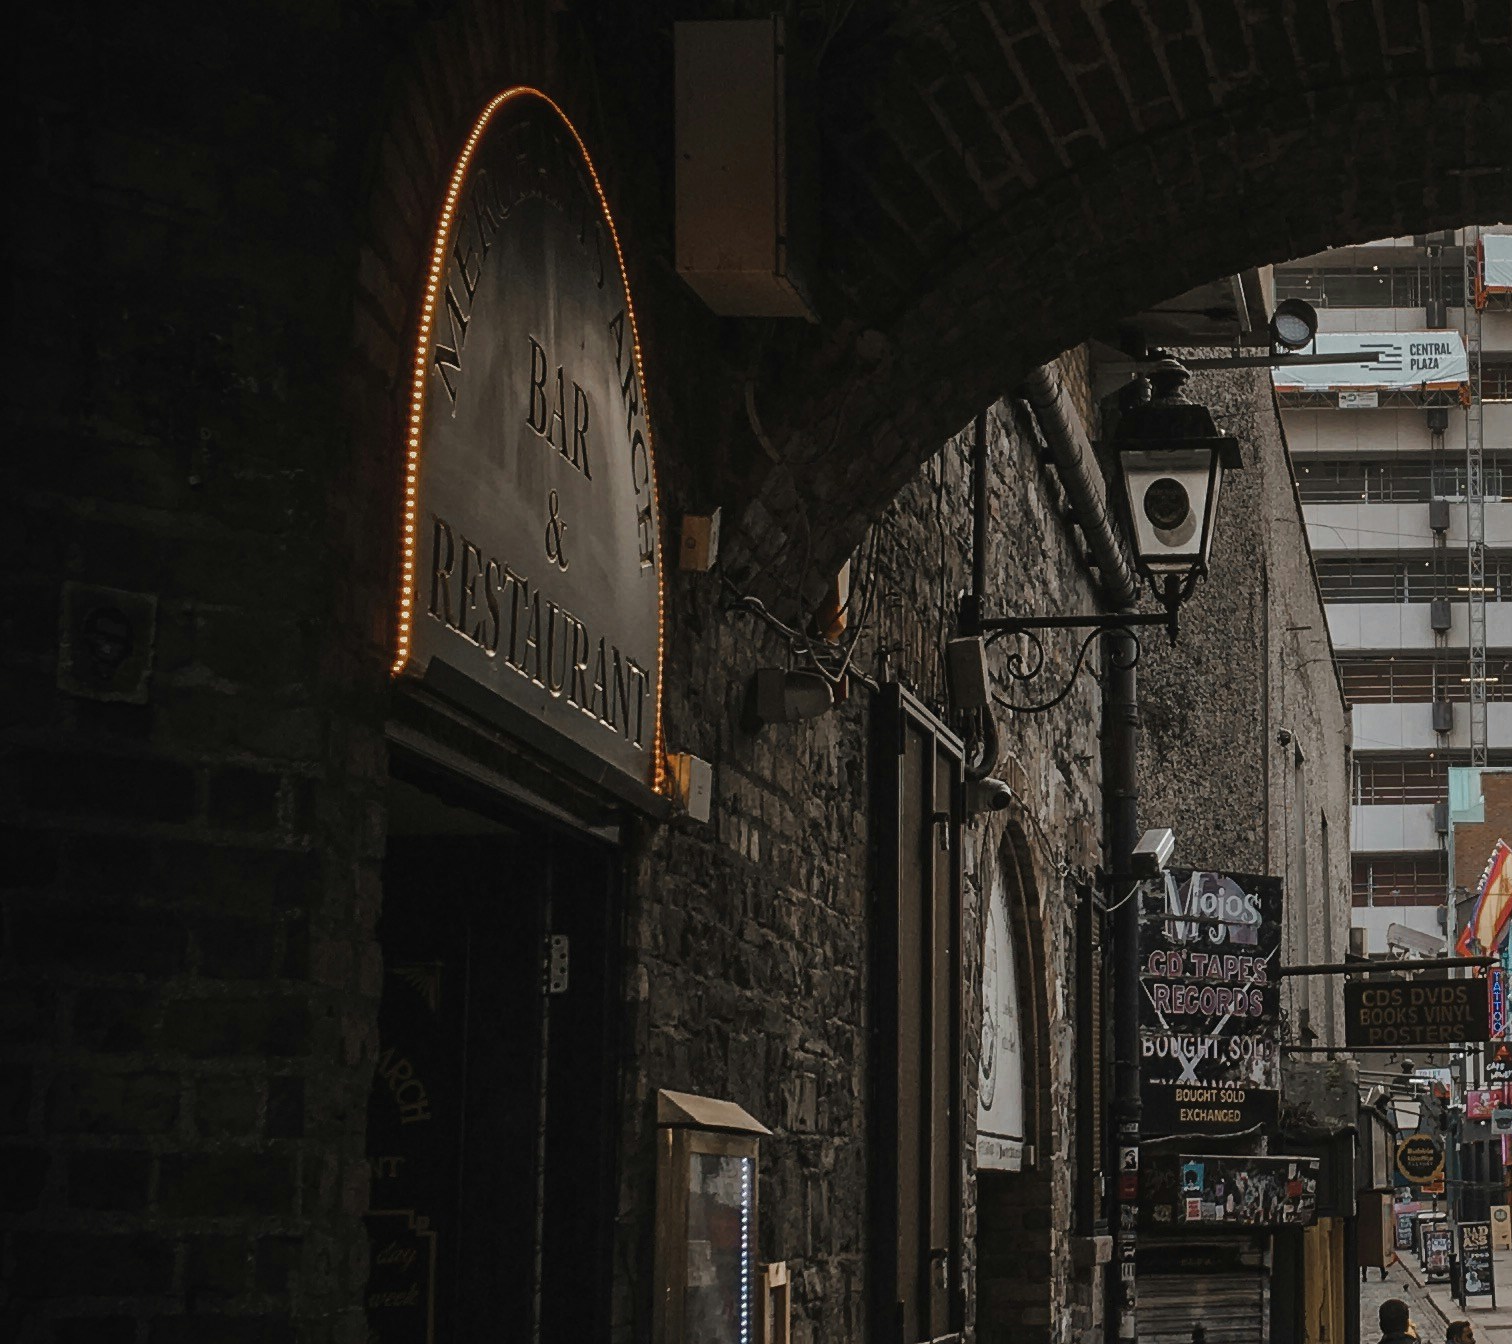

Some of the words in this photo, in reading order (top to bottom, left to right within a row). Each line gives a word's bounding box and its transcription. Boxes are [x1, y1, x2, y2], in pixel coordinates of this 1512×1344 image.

[1409, 343, 1452, 357] CENTRAL
[1410, 358, 1440, 370] PLAZA
[526, 333, 592, 480] BAR
[546, 489, 569, 572] &
[427, 513, 651, 751] RESTAURANT
[1191, 953, 1267, 986] TAPES
[1154, 984, 1263, 1017] RECORDS
[1362, 988, 1402, 1007] CDS
[1410, 986, 1468, 1005] DVDS
[1492, 971, 1502, 1032] TATTOO
[1360, 1006, 1418, 1025] BOOKS
[1424, 1005, 1475, 1024] VINYL
[1369, 1024, 1465, 1044] POSTERS
[1175, 1088, 1217, 1102] BOUGHT
[1220, 1090, 1246, 1103] SOLD
[1180, 1108, 1241, 1123] EXCHANGED
